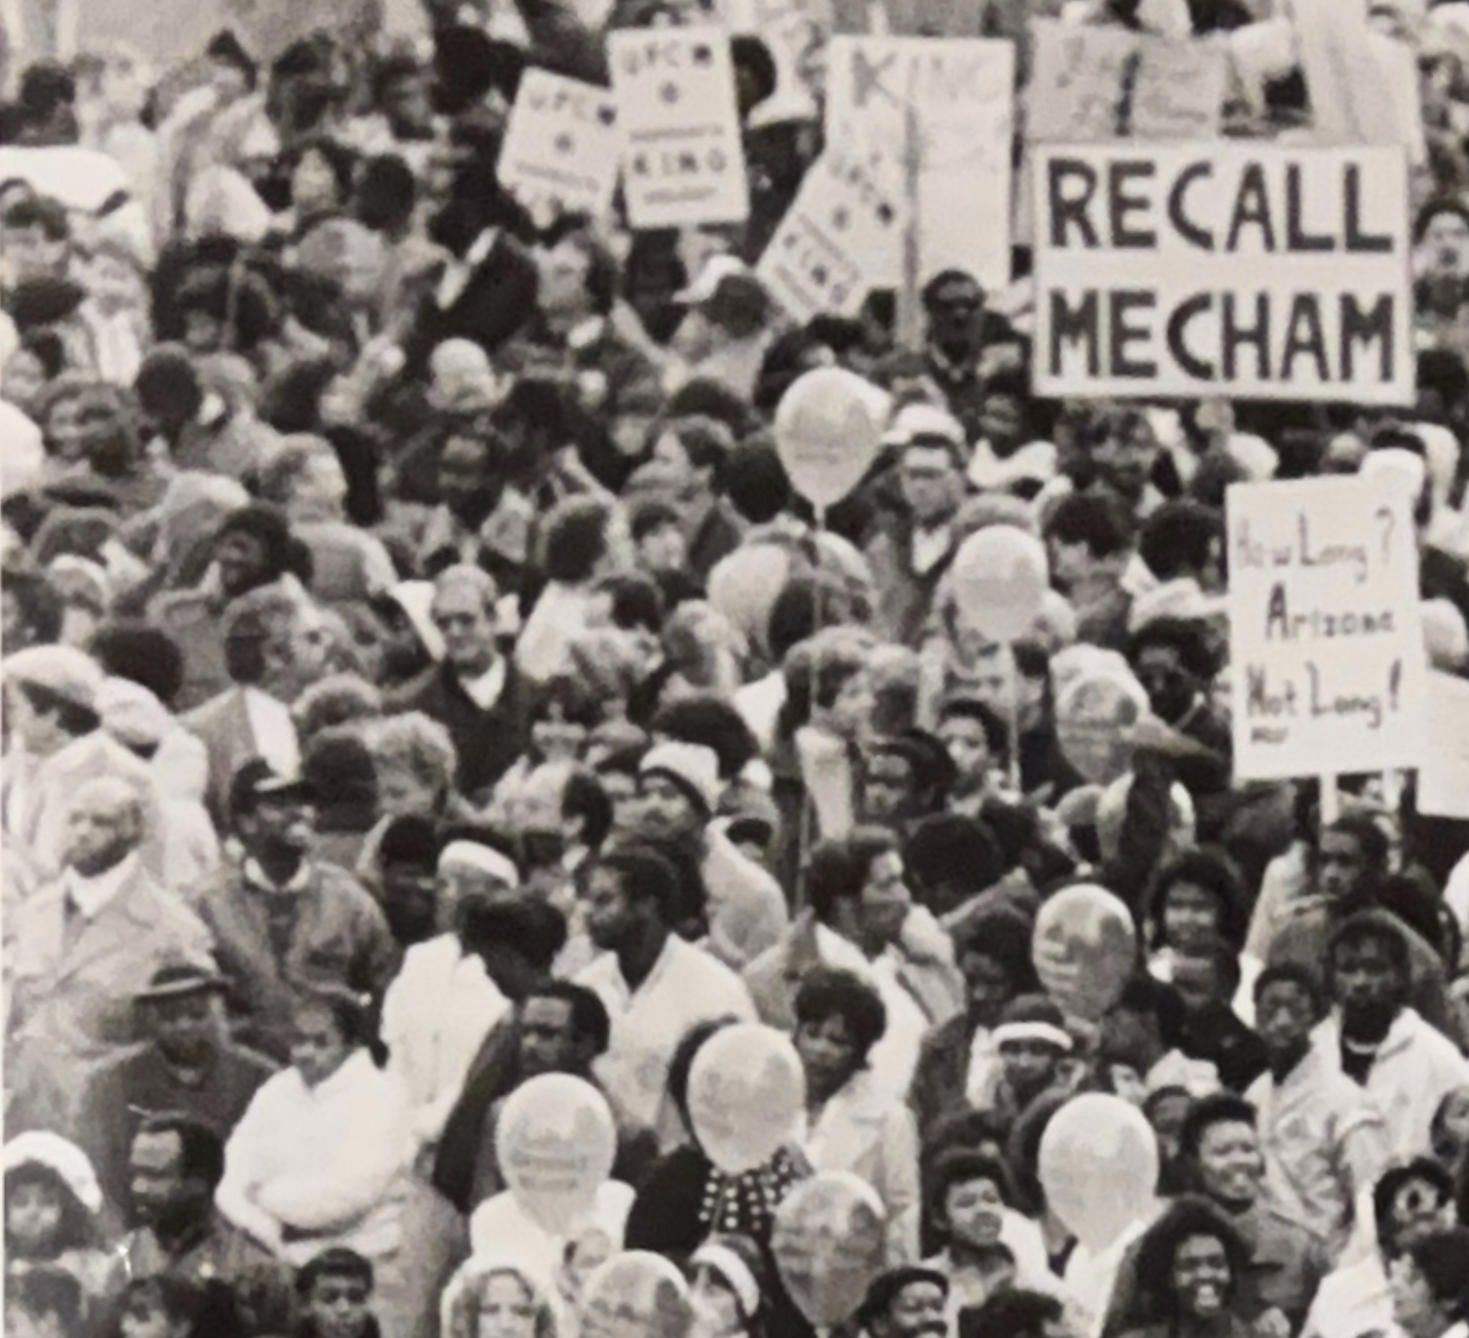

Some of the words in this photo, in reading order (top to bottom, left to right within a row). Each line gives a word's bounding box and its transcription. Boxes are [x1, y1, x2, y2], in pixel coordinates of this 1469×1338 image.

[1048, 158, 1394, 253] RECALL
[1048, 289, 1395, 383] MECHAM
[1246, 660, 1298, 716] Not
